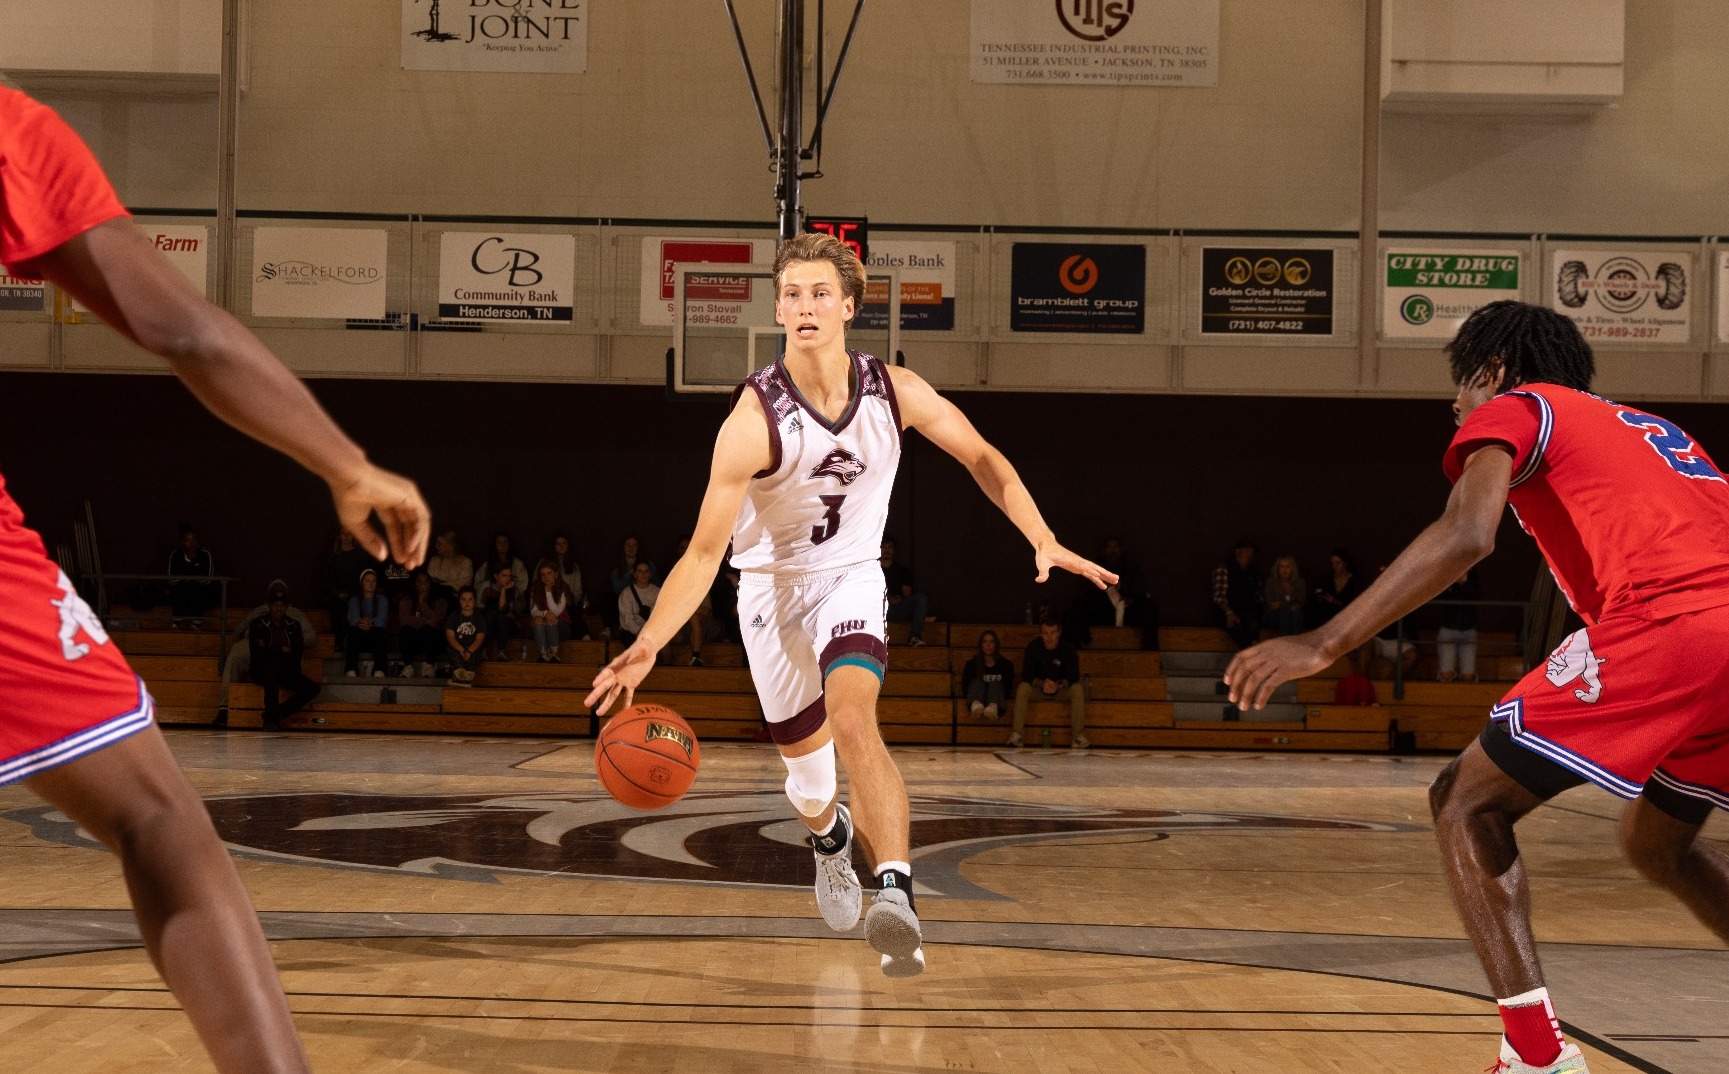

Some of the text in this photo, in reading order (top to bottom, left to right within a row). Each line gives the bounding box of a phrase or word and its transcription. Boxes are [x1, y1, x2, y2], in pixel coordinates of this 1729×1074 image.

[466, 15, 579, 43] JOINT
[519, 44, 534, 52] You
[980, 43, 1047, 53] TENNESSEE
[1050, 44, 1121, 54] INDUSTRIAL
[996, 57, 1040, 66] MILLER
[1042, 57, 1089, 67] AVENUE
[1160, 58, 1175, 68] TN
[155, 234, 199, 252] Farm
[866, 253, 904, 267] oples
[908, 253, 945, 267] Bank
[1390, 256, 1515, 272] CITY DRUG
[258, 262, 378, 281] SHACKELFORD
[690, 274, 747, 285] SERVICE
[1415, 271, 1490, 286] STORE
[12, 289, 21, 298] TN
[22, 289, 42, 298] 38340
[454, 288, 558, 304] Community Bank
[1209, 287, 1326, 297] Golden Circle Restoration
[667, 303, 742, 314] Sron Stovall
[1018, 297, 1138, 309] bramblett group
[459, 305, 553, 320] Henderson, TN
[671, 313, 738, 324] -989-4662
[1229, 320, 1303, 330] (731) 407-4822
[1582, 325, 1661, 337] 731-989-2837
[1616, 410, 1728, 485] 2
[810, 494, 848, 546] 3
